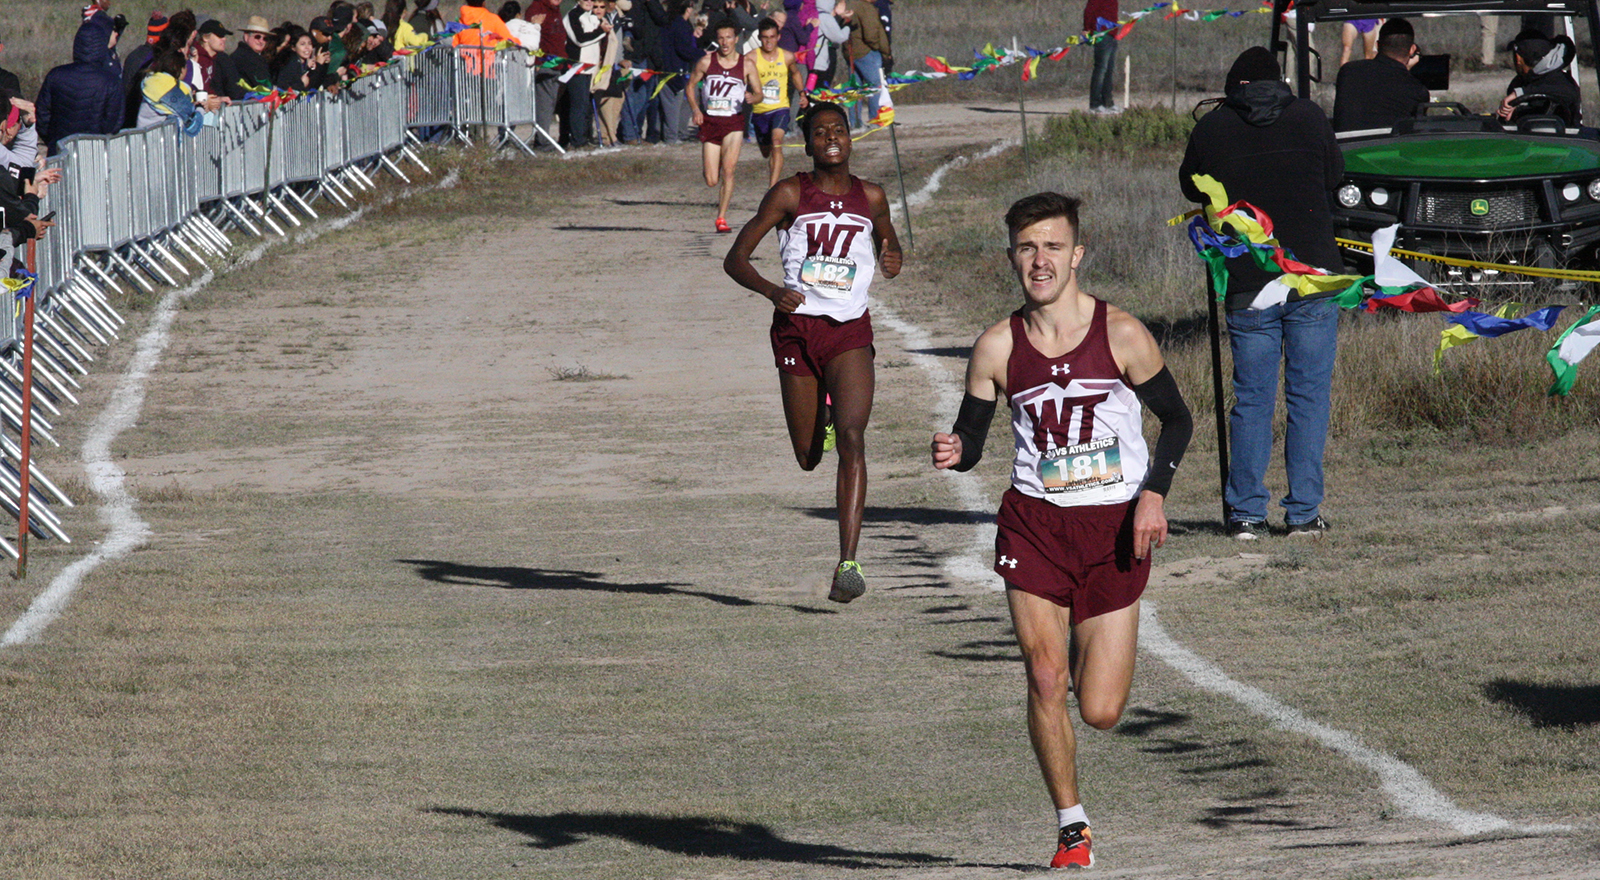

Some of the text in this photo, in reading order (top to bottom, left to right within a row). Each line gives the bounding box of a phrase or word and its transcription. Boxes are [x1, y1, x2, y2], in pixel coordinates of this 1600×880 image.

[709, 80, 738, 97] WT
[711, 101, 729, 109] 178
[806, 223, 865, 259] WT
[812, 263, 850, 283] 182
[1022, 391, 1110, 452] WT
[1055, 438, 1114, 456] VS ATHLETICS
[1053, 451, 1108, 481] 181
